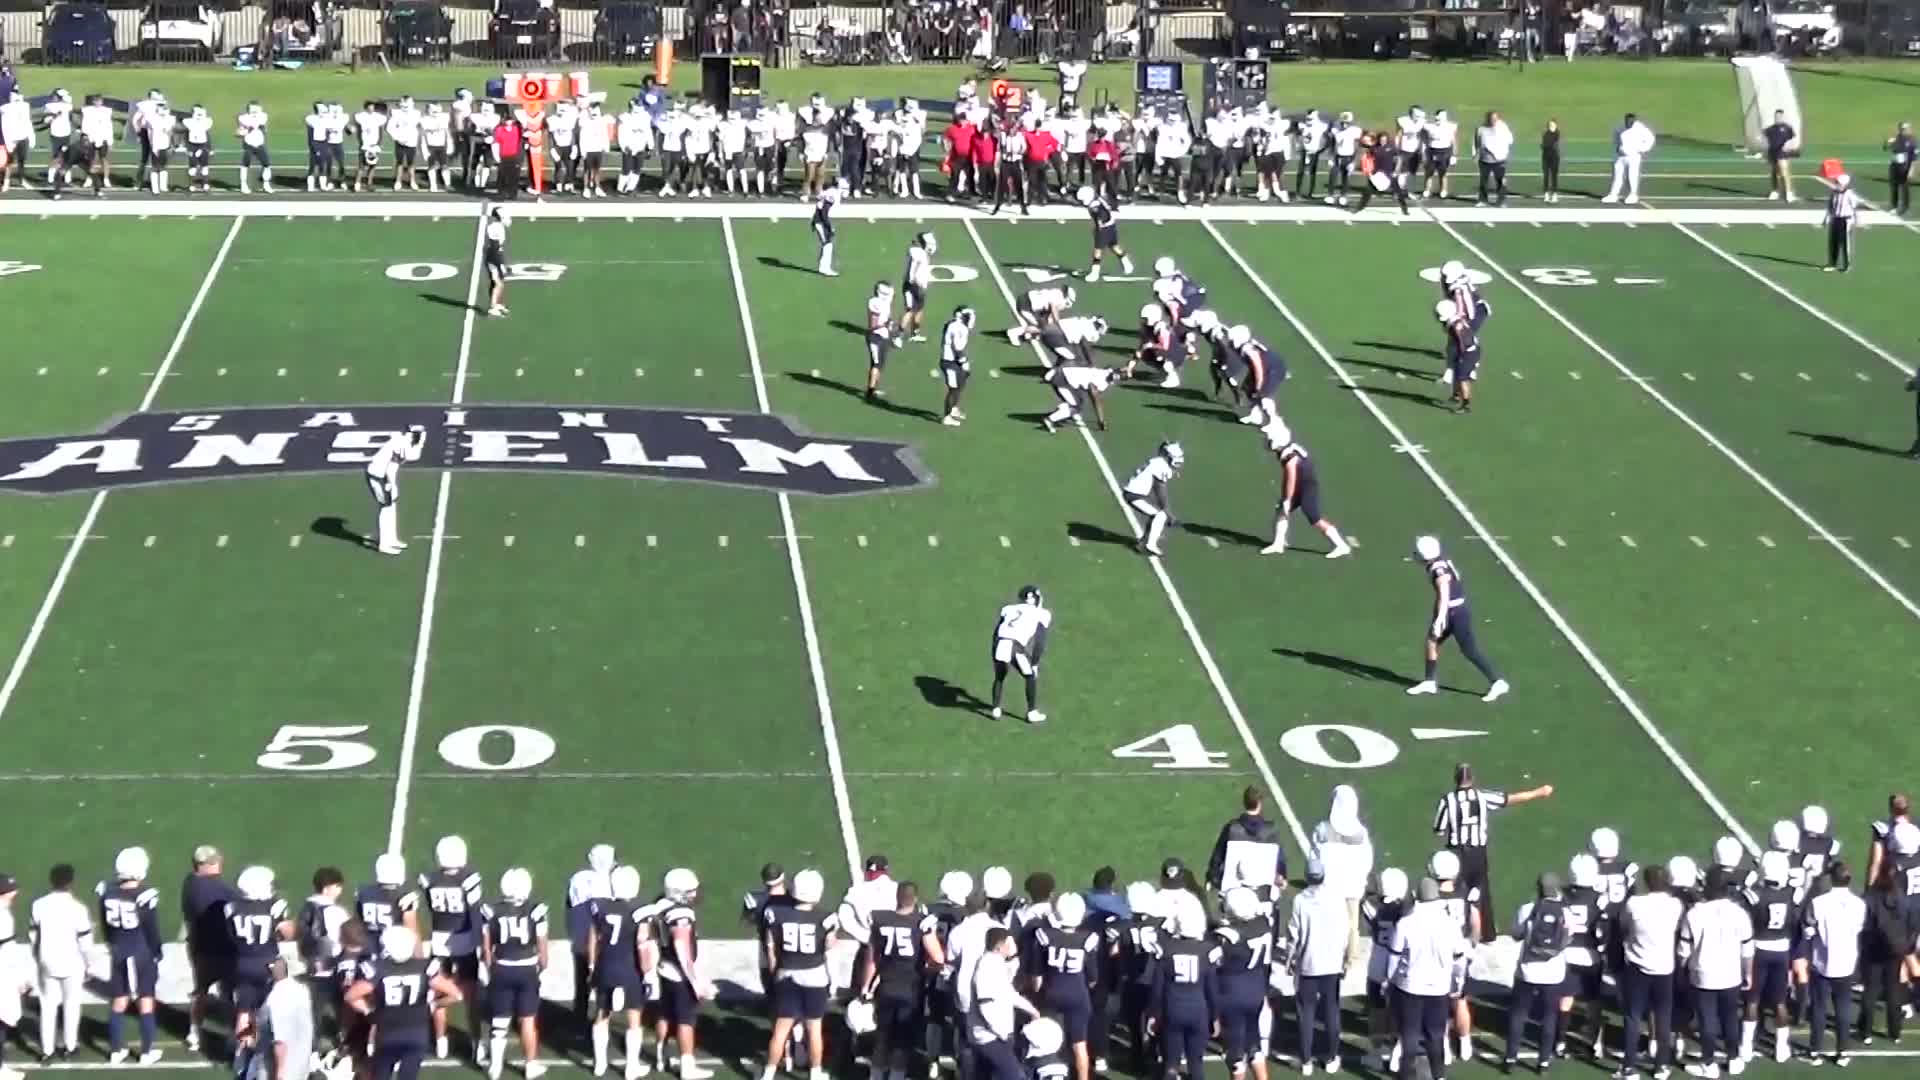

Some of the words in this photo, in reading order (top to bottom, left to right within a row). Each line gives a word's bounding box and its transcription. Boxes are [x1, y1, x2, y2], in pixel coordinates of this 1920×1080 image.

[168, 410, 733, 433] SAINT
[0, 431, 887, 482] ANSELM
[256, 724, 557, 772] 50
[1112, 723, 1400, 768] 40
[1460, 800, 1478, 825] L
[104, 897, 140, 929] 26
[231, 915, 273, 946] 47
[498, 915, 530, 945] 14
[605, 914, 624, 946] 7
[781, 921, 817, 954] 96
[879, 926, 915, 957] 75
[1047, 945, 1085, 974] 43
[382, 974, 421, 1006] 67
